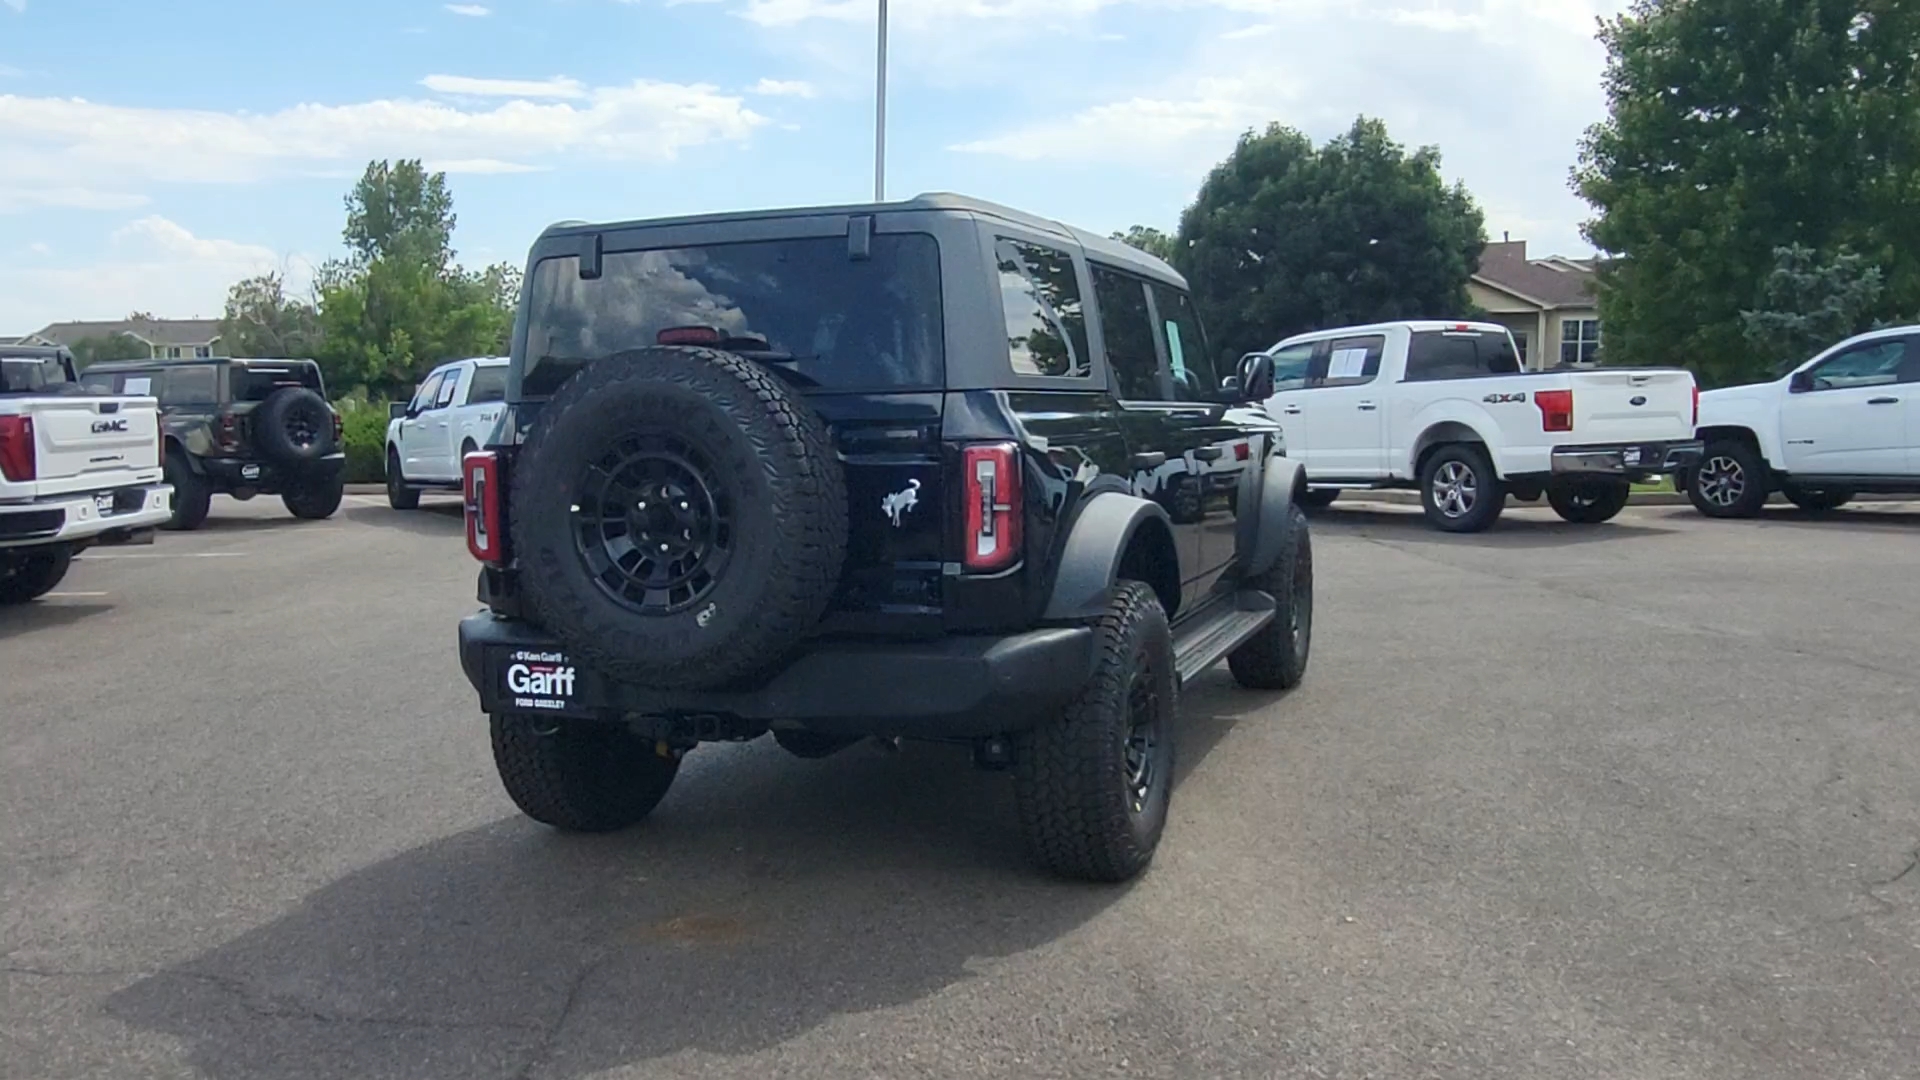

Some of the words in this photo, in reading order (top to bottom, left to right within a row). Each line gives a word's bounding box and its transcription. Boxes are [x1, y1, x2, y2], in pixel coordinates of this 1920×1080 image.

[91, 420, 128, 434] GMC
[524, 651, 541, 662] Ken
[541, 652, 562, 663] Garff
[508, 664, 575, 696] Garff
[515, 698, 534, 707] FORD
